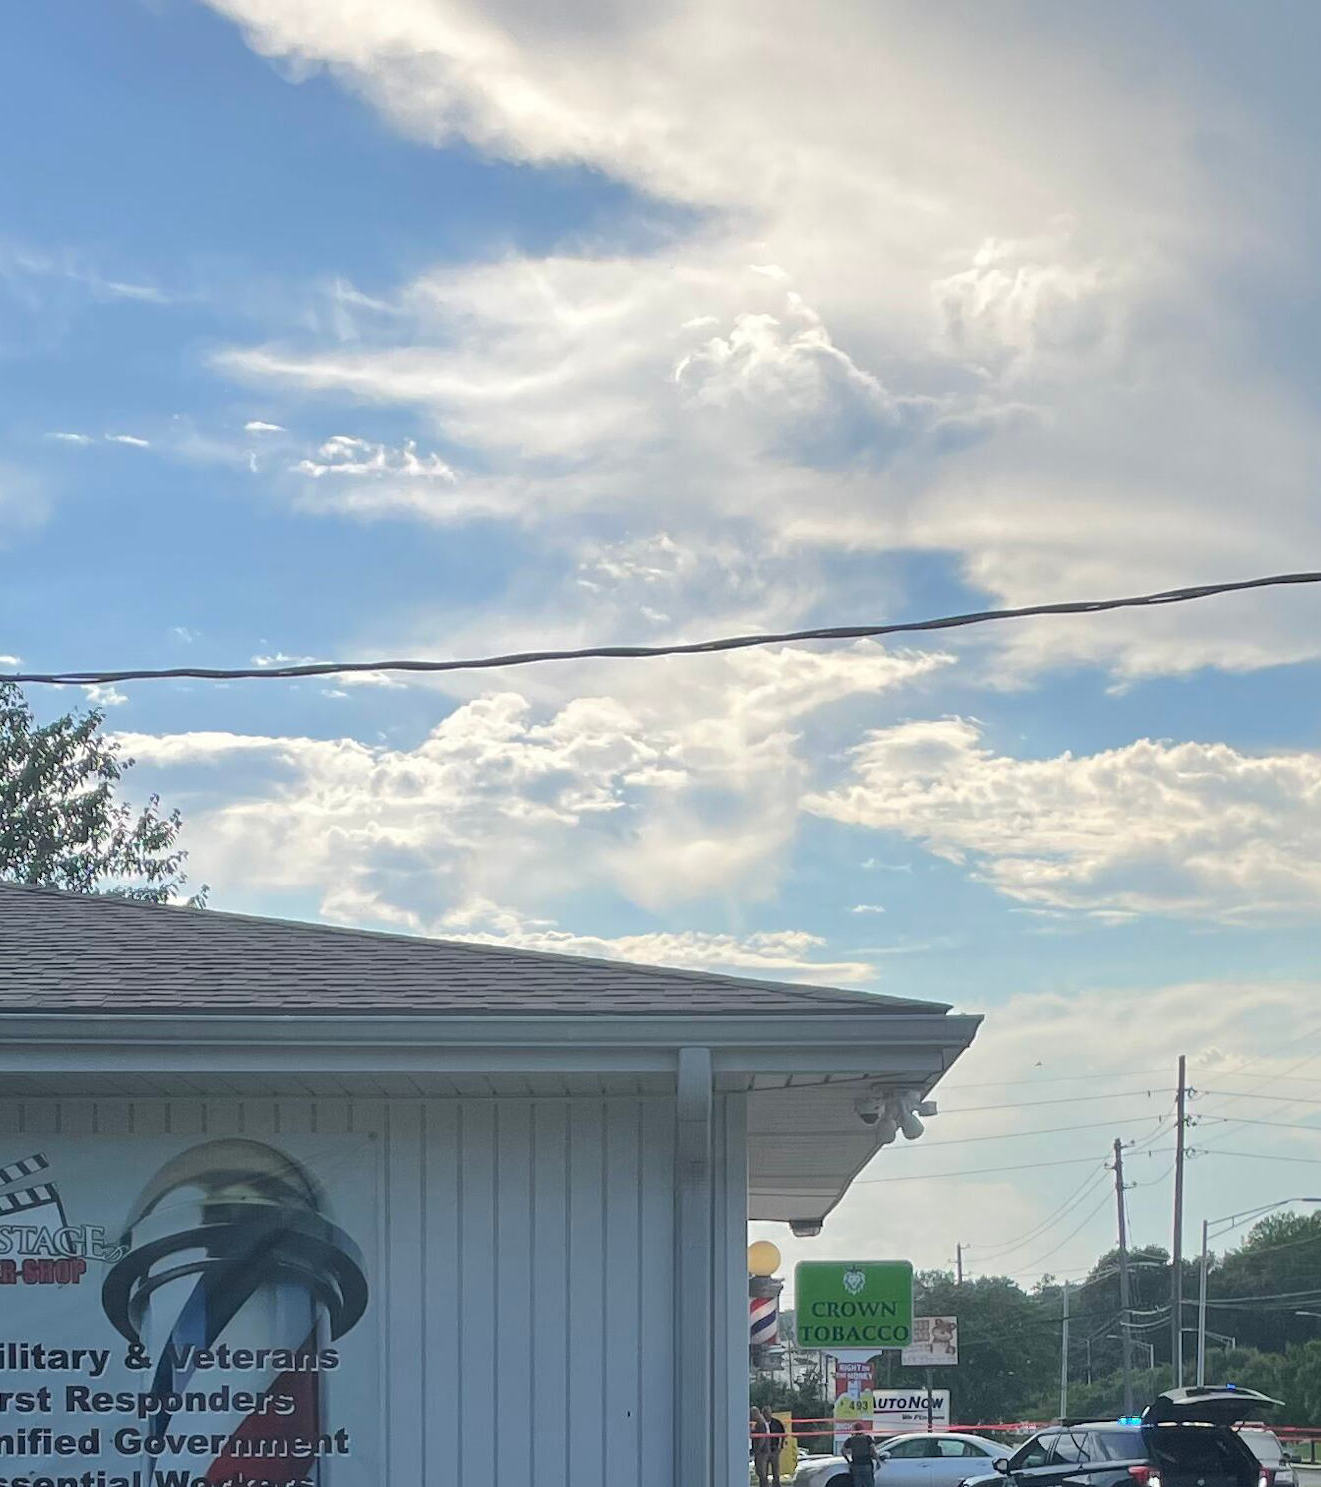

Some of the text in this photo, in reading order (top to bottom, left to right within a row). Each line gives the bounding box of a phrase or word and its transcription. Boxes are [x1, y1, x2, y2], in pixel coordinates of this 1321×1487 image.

[811, 1301, 897, 1318] CROWN
[800, 1325, 909, 1342] TOBACCO
[124, 1343, 153, 1372] &
[172, 1343, 340, 1372] Veterans
[65, 1385, 296, 1419] Responders
[114, 1428, 350, 1457] Government
